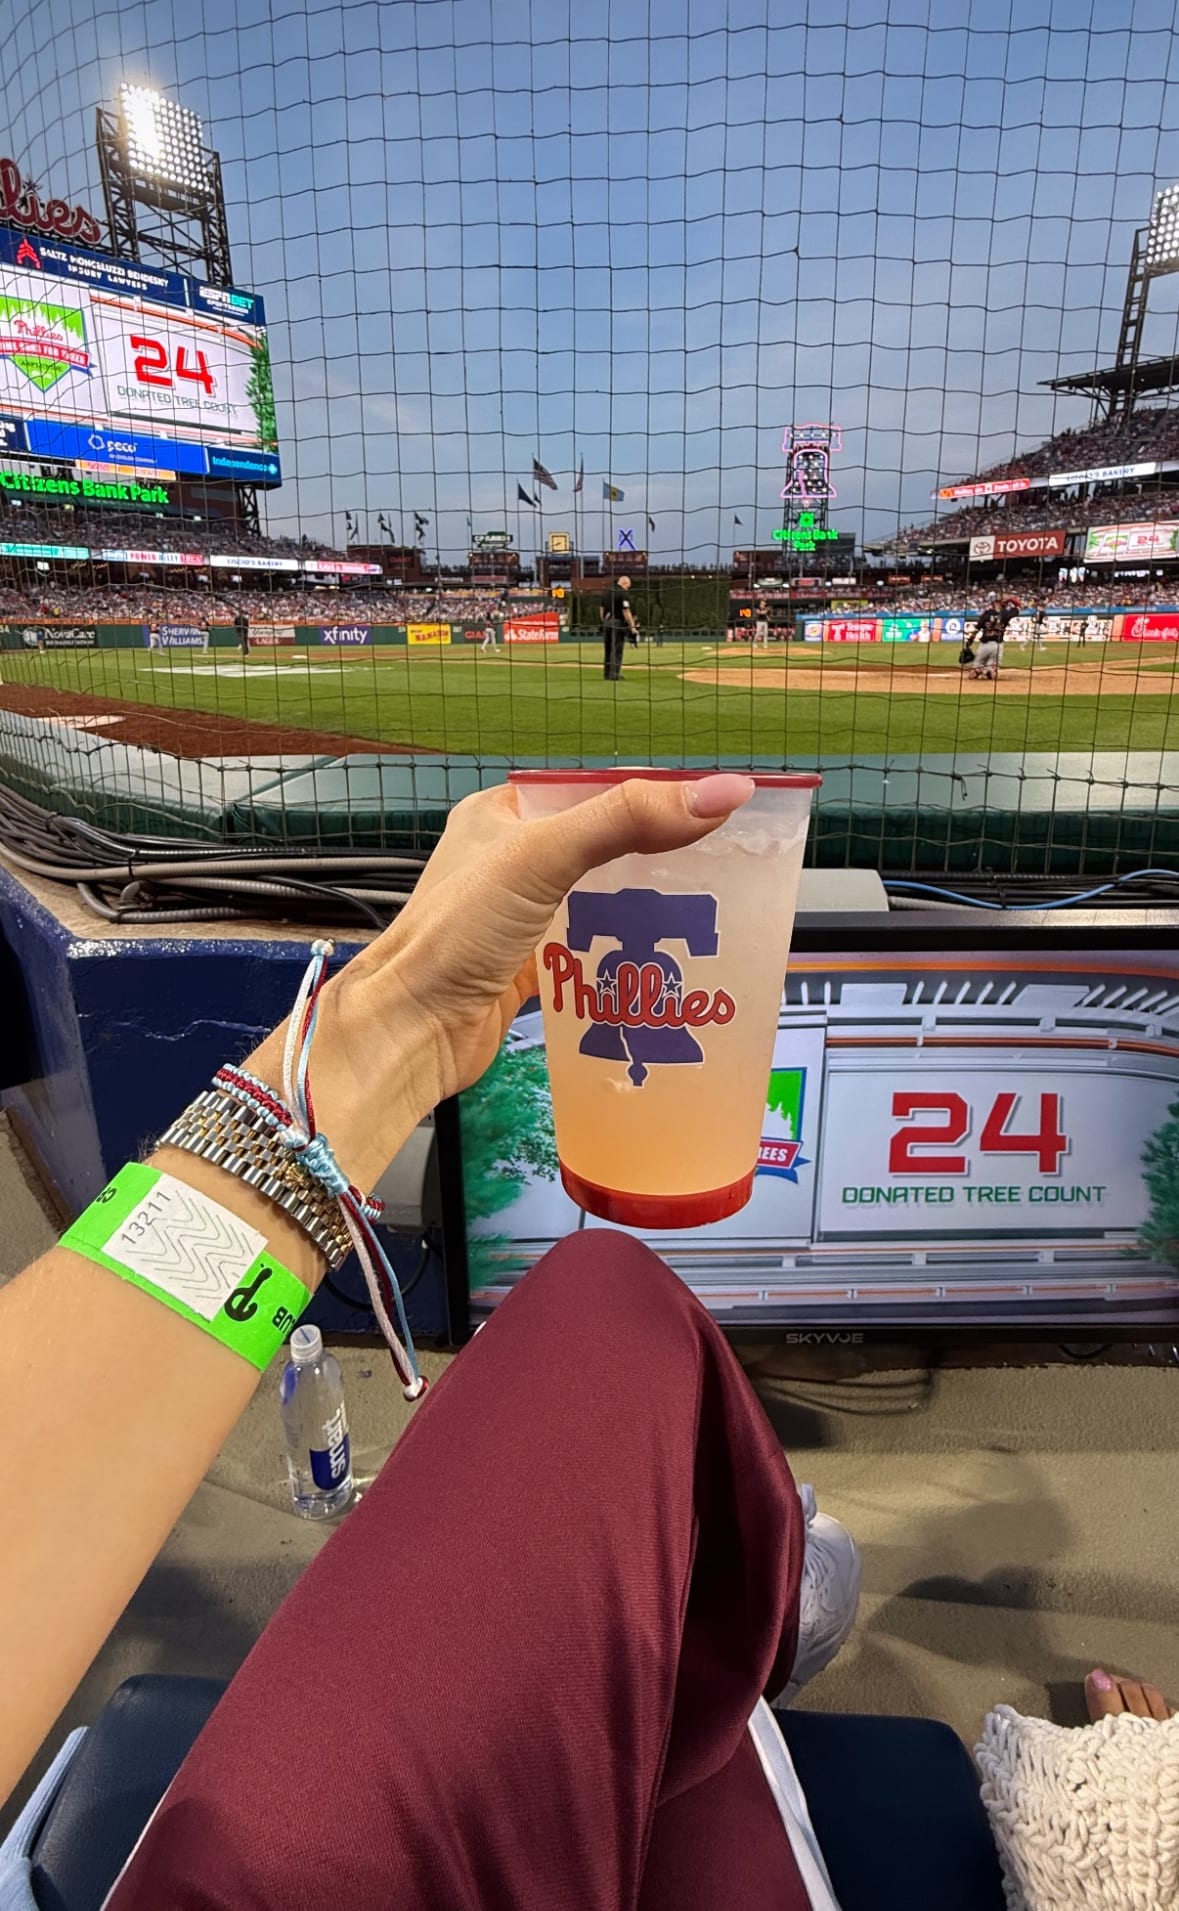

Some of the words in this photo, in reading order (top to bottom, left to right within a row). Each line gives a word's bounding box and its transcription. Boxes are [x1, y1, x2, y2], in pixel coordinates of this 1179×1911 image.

[129, 334, 214, 395] 24
[117, 385, 172, 404] DONATED
[174, 396, 200, 409] TREE
[212, 456, 268, 472] Independence
[0, 470, 80, 495] Citizens
[82, 478, 128, 499] Bank
[129, 484, 169, 504] Park
[997, 536, 1059, 553] TOYOTA
[45, 627, 96, 639] NovaCare
[323, 626, 368, 645] xfinity
[543, 942, 737, 1029] Phillies
[888, 1091, 1069, 1175] 24
[841, 1186, 955, 1204] DONATED
[963, 1185, 1020, 1203] TREE
[1028, 1185, 1107, 1203] COUNT
[121, 1190, 171, 1246] 13211
